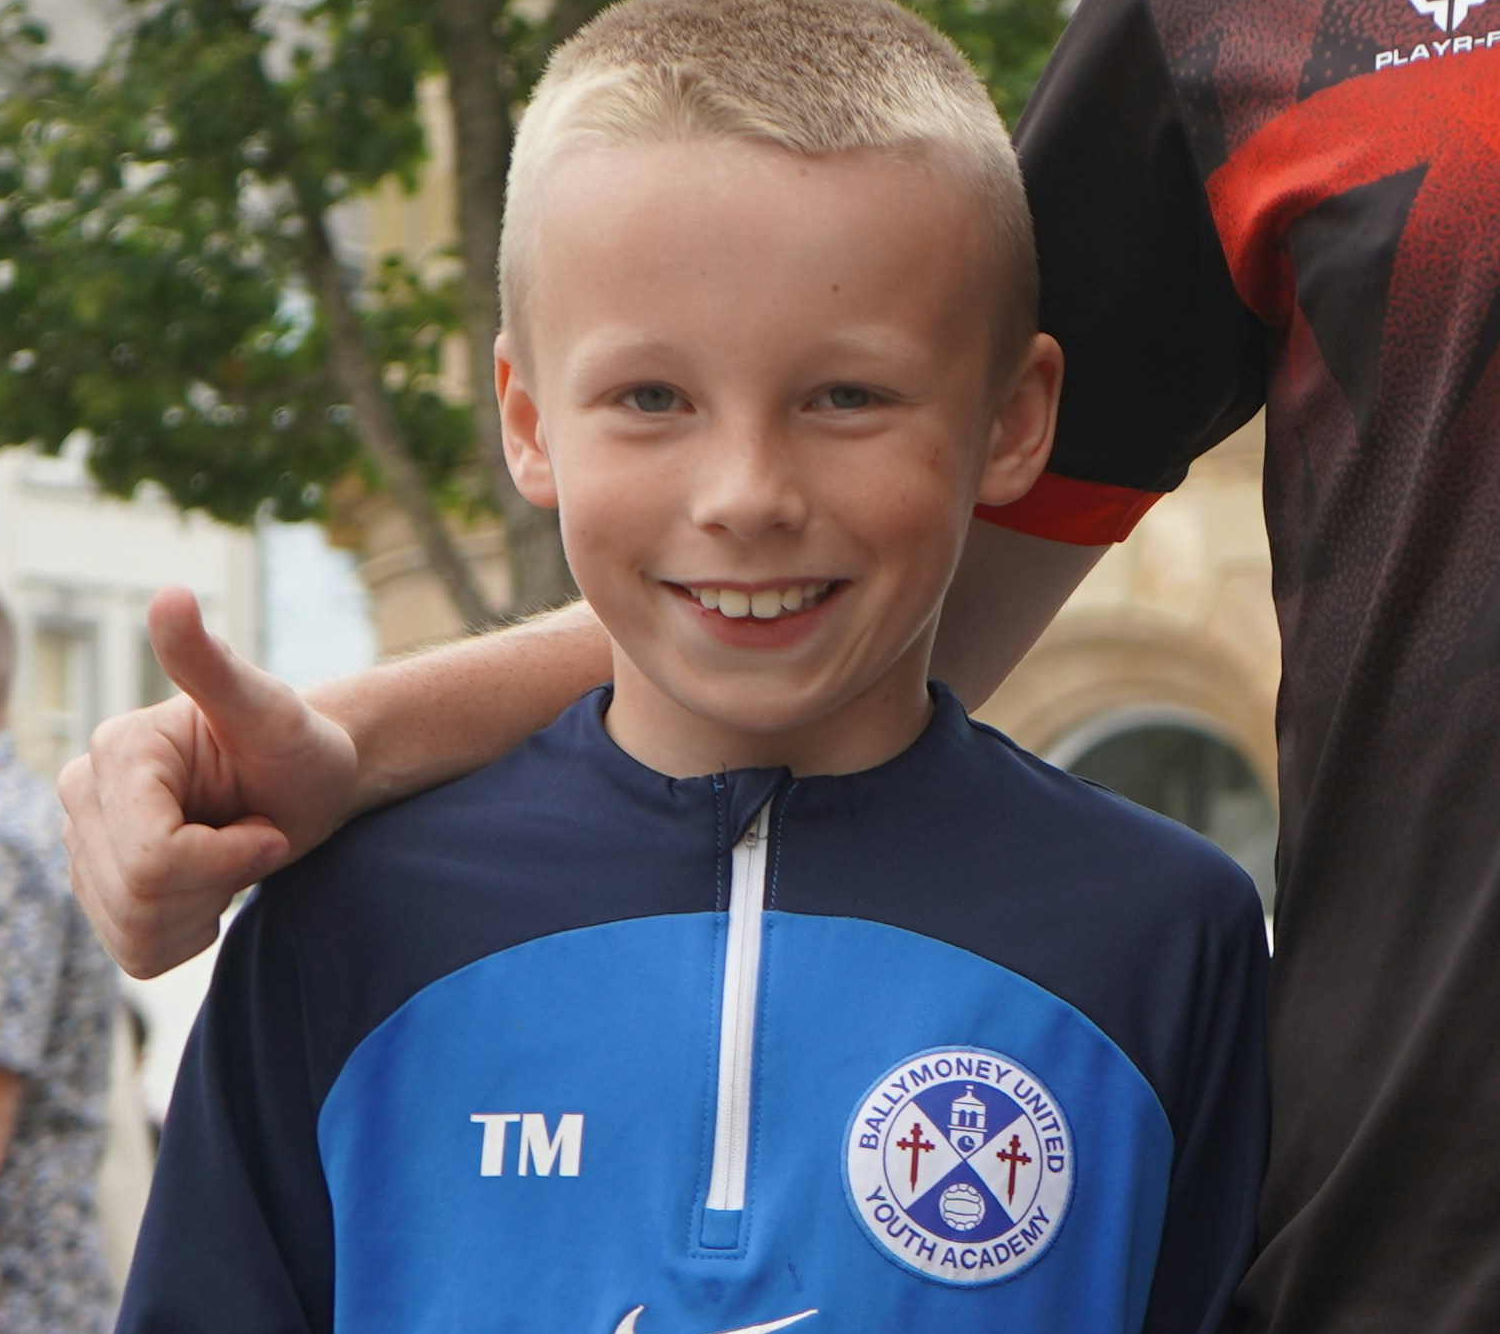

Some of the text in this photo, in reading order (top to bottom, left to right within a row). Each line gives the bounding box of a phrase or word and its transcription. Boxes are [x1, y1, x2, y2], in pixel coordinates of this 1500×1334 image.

[470, 1113, 585, 1178] TM
[858, 1056, 1066, 1175] BALLYMONEY UNITED
[864, 1185, 1051, 1271] YOUTH ACADEMY
